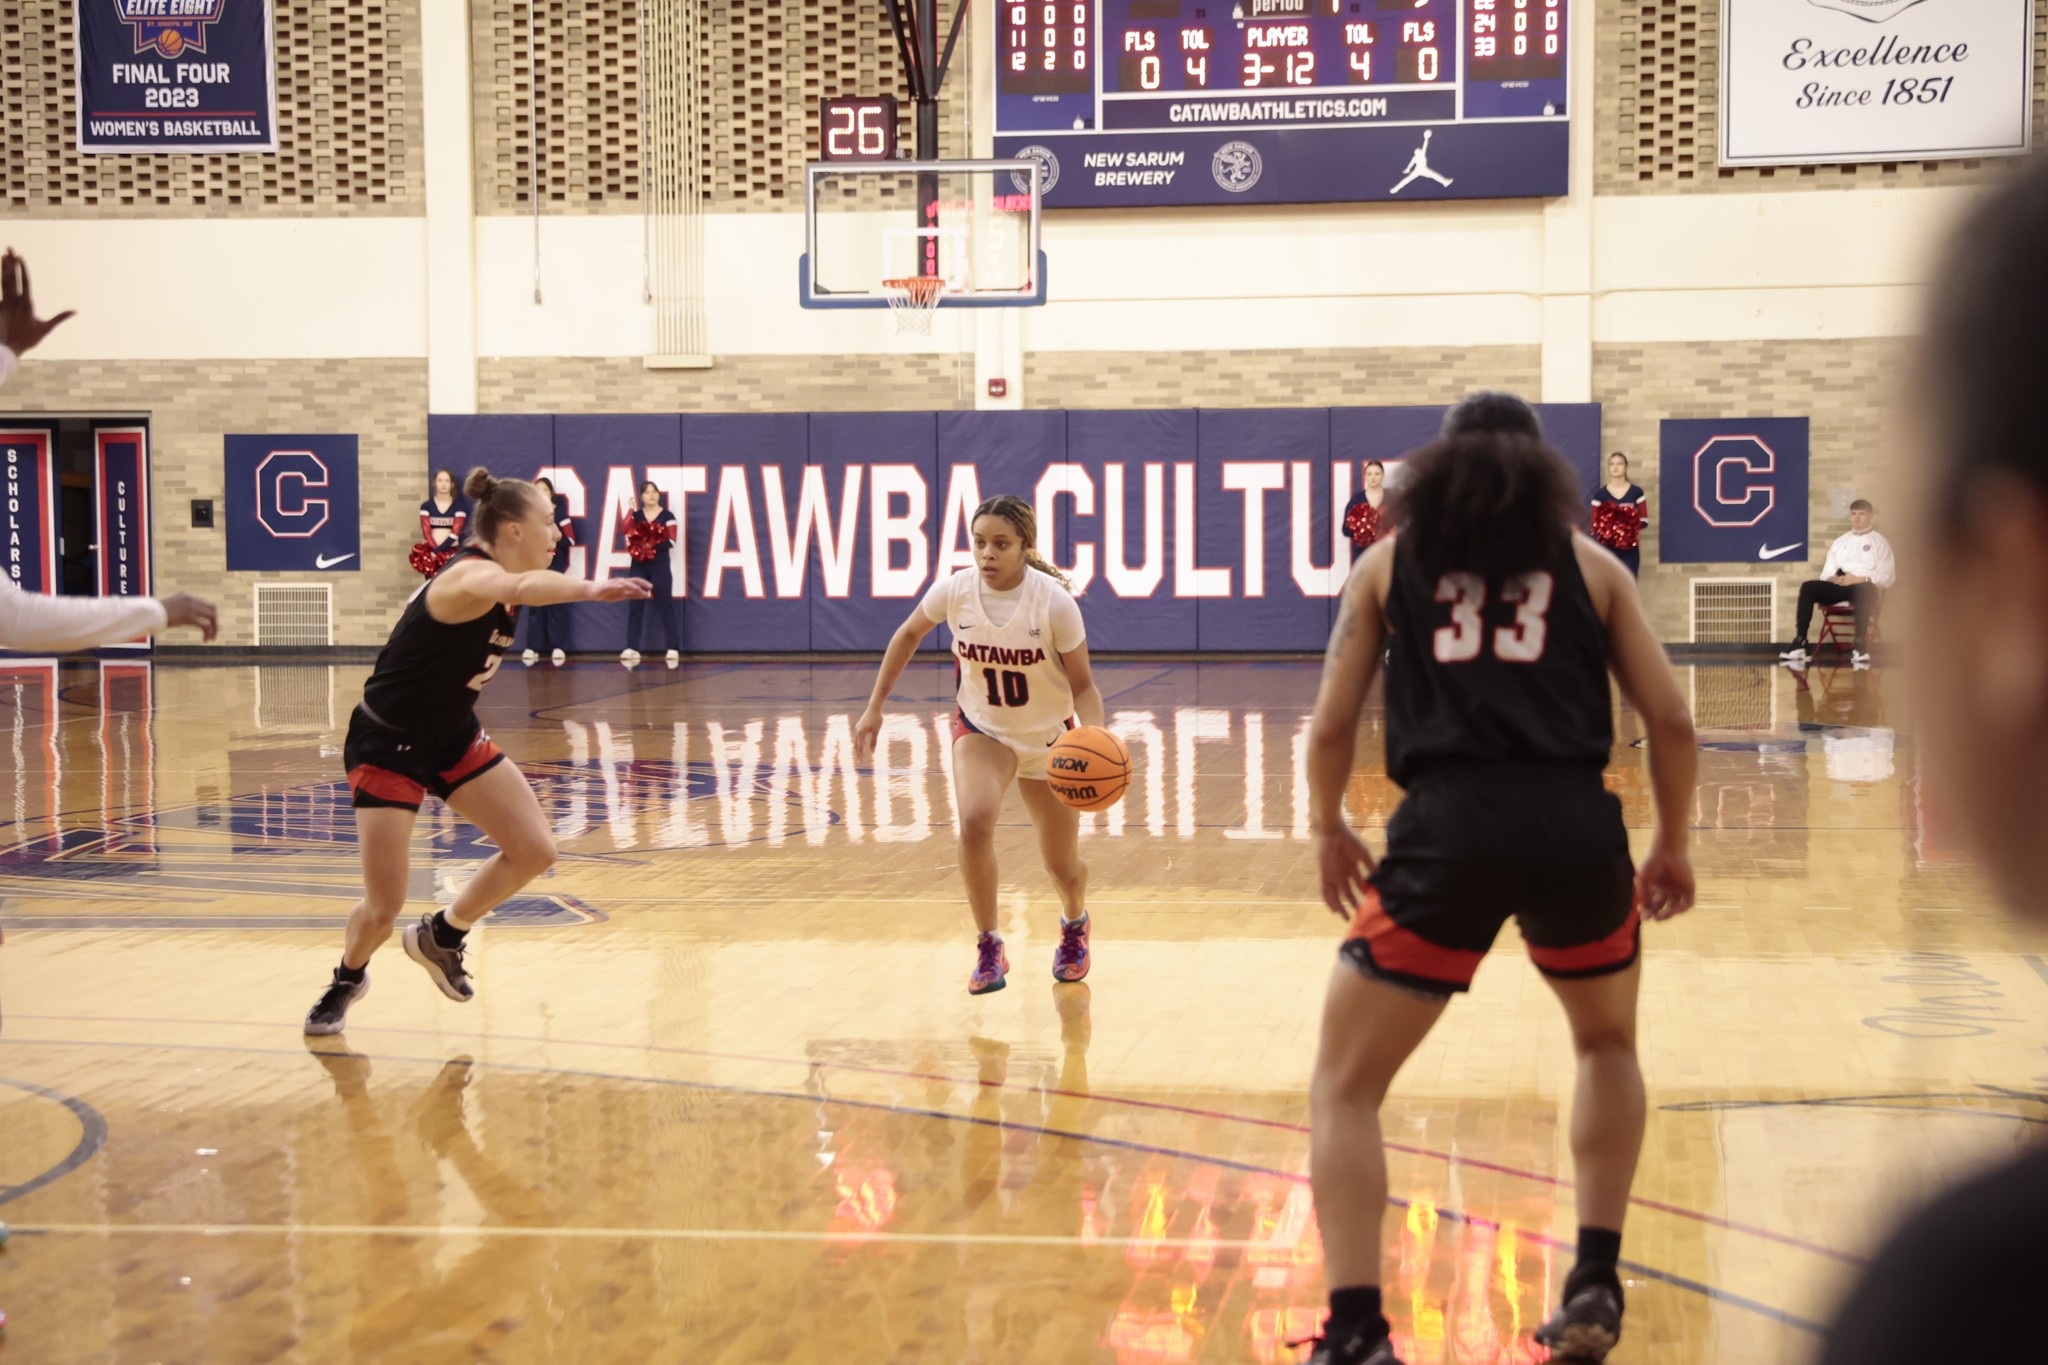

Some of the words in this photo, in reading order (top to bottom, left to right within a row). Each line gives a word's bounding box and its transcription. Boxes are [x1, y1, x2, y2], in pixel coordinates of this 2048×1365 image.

[126, 0, 167, 15] ELITE
[170, 0, 216, 15] EIGHT
[1012, 6, 1026, 25] 10
[1044, 5, 1056, 24] 0
[1074, 4, 1085, 24] 0
[1474, 13, 1496, 33] 24
[1514, 12, 1527, 32] 0
[1545, 11, 1558, 31] 0
[1012, 29, 1026, 47] 11
[1044, 28, 1056, 47] 0
[1074, 27, 1085, 47] 0
[1125, 31, 1155, 51] FLS
[1181, 29, 1209, 50] TOL
[1247, 25, 1309, 48] PLAYER
[1345, 23, 1374, 44] TOL
[1403, 21, 1435, 42] FLS
[1474, 37, 1496, 57] 33
[1514, 35, 1527, 55] 0
[1545, 34, 1558, 54] 0
[1012, 52, 1026, 71] 12
[1044, 51, 1056, 70] 2
[1074, 50, 1085, 70] 0
[1782, 35, 1970, 71] Excellence
[112, 63, 171, 84] FINAL
[177, 62, 230, 83] FOUR
[1140, 56, 1160, 89] 0
[1186, 56, 1206, 85] 4
[1350, 51, 1370, 81] 4
[1418, 47, 1438, 80] 0
[145, 87, 200, 108] 2023
[1795, 82, 1872, 109] Since
[1881, 76, 1955, 106] 1851
[1169, 98, 1387, 122] CATAWBAATHLETICS.COM
[90, 120, 159, 137] WOMEN'S
[164, 119, 261, 137] BASKETBALL
[829, 106, 884, 155] 26
[1084, 152, 1125, 168] NEW
[1125, 151, 1185, 167] SARUM
[1095, 171, 1176, 186] BREWERY
[117, 480, 129, 595] CULTURE
[1433, 569, 1554, 664] 33
[958, 640, 1047, 666] CATAWBA
[982, 667, 1030, 708] 10
[1052, 756, 1089, 773] NCAA
